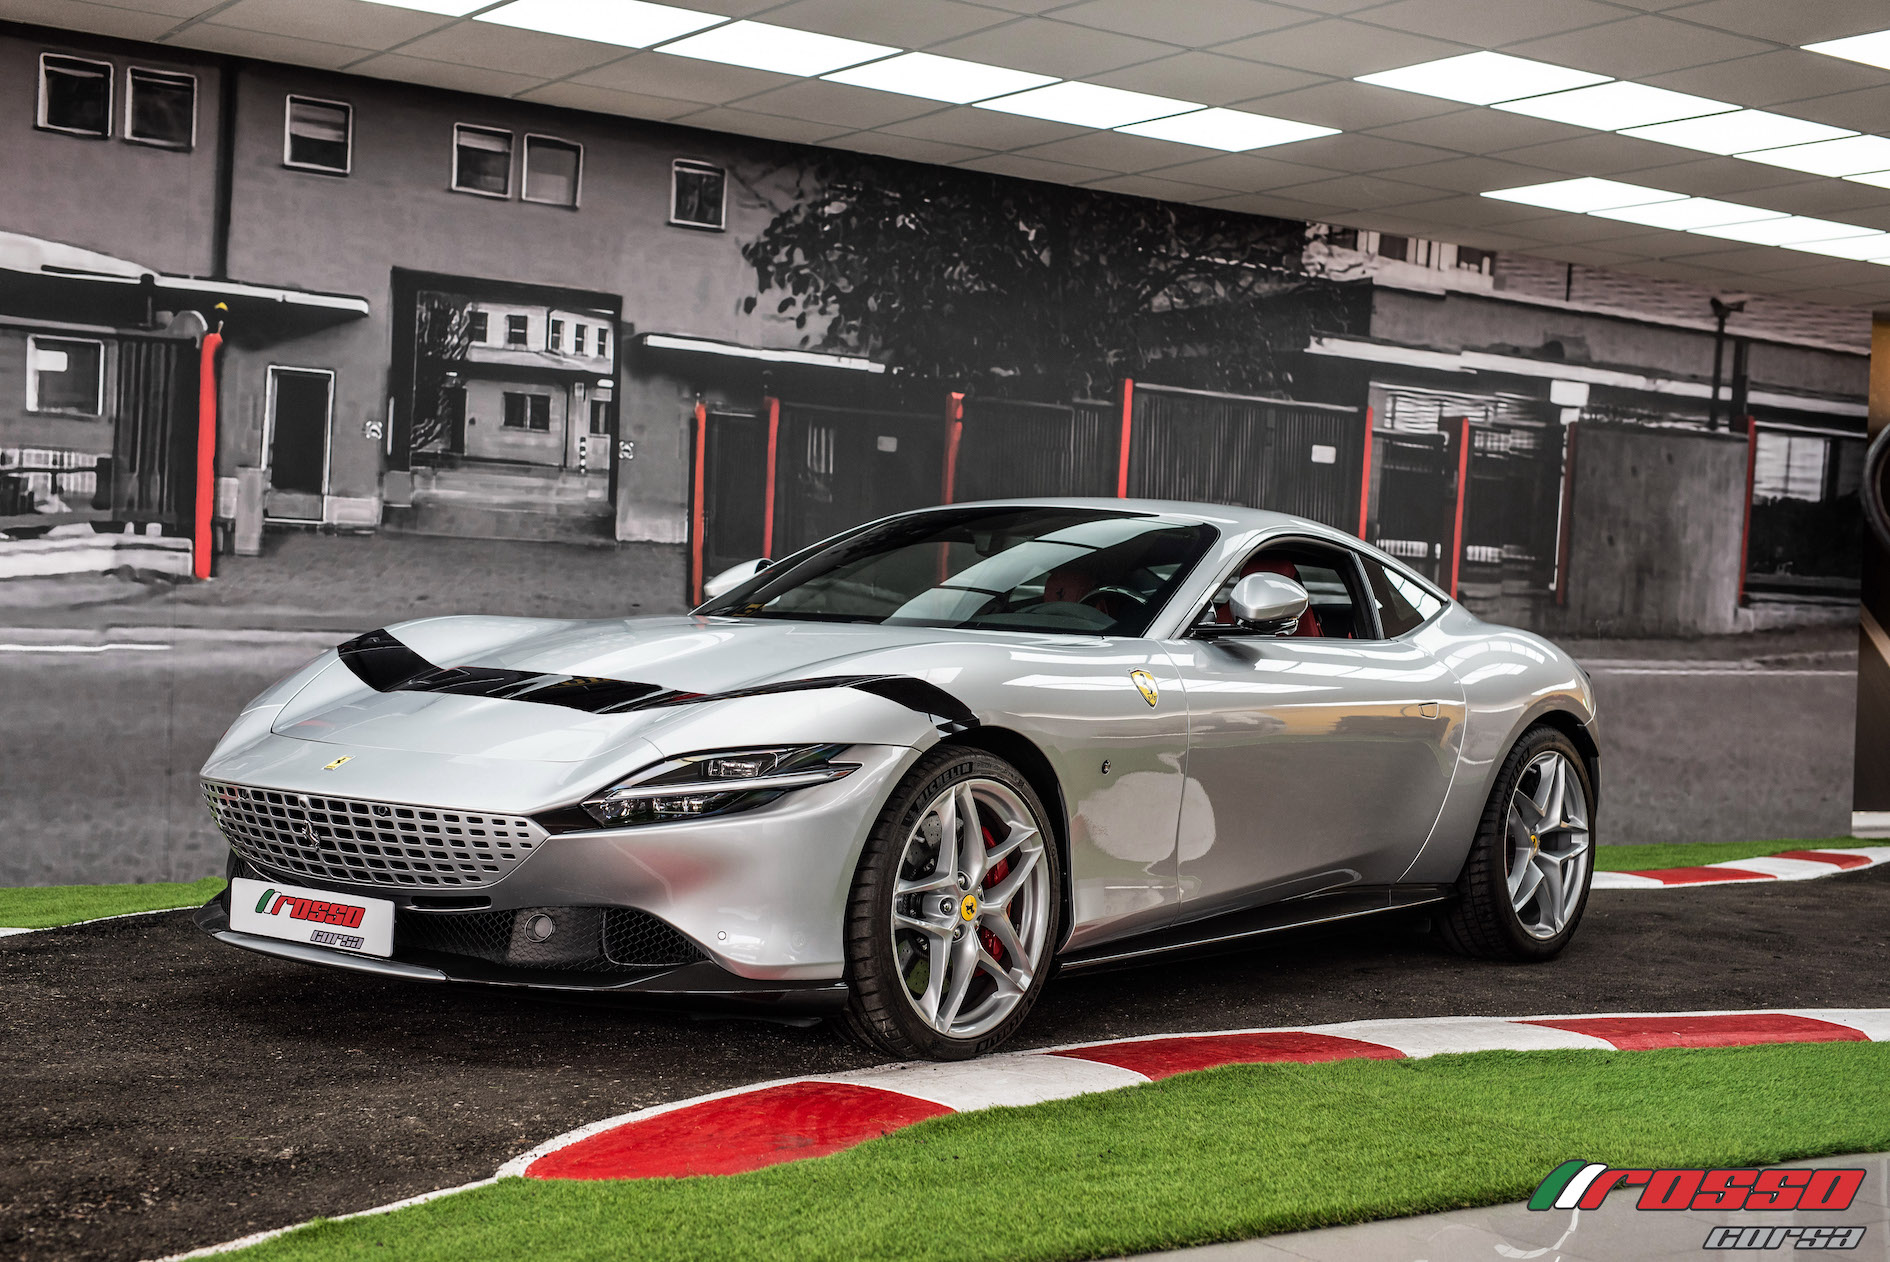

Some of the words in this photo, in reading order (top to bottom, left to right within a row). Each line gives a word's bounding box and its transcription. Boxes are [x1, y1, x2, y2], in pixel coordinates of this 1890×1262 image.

[915, 762, 972, 810] MICHELIN
[271, 895, 366, 929] rosso
[310, 929, 365, 950] corsa
